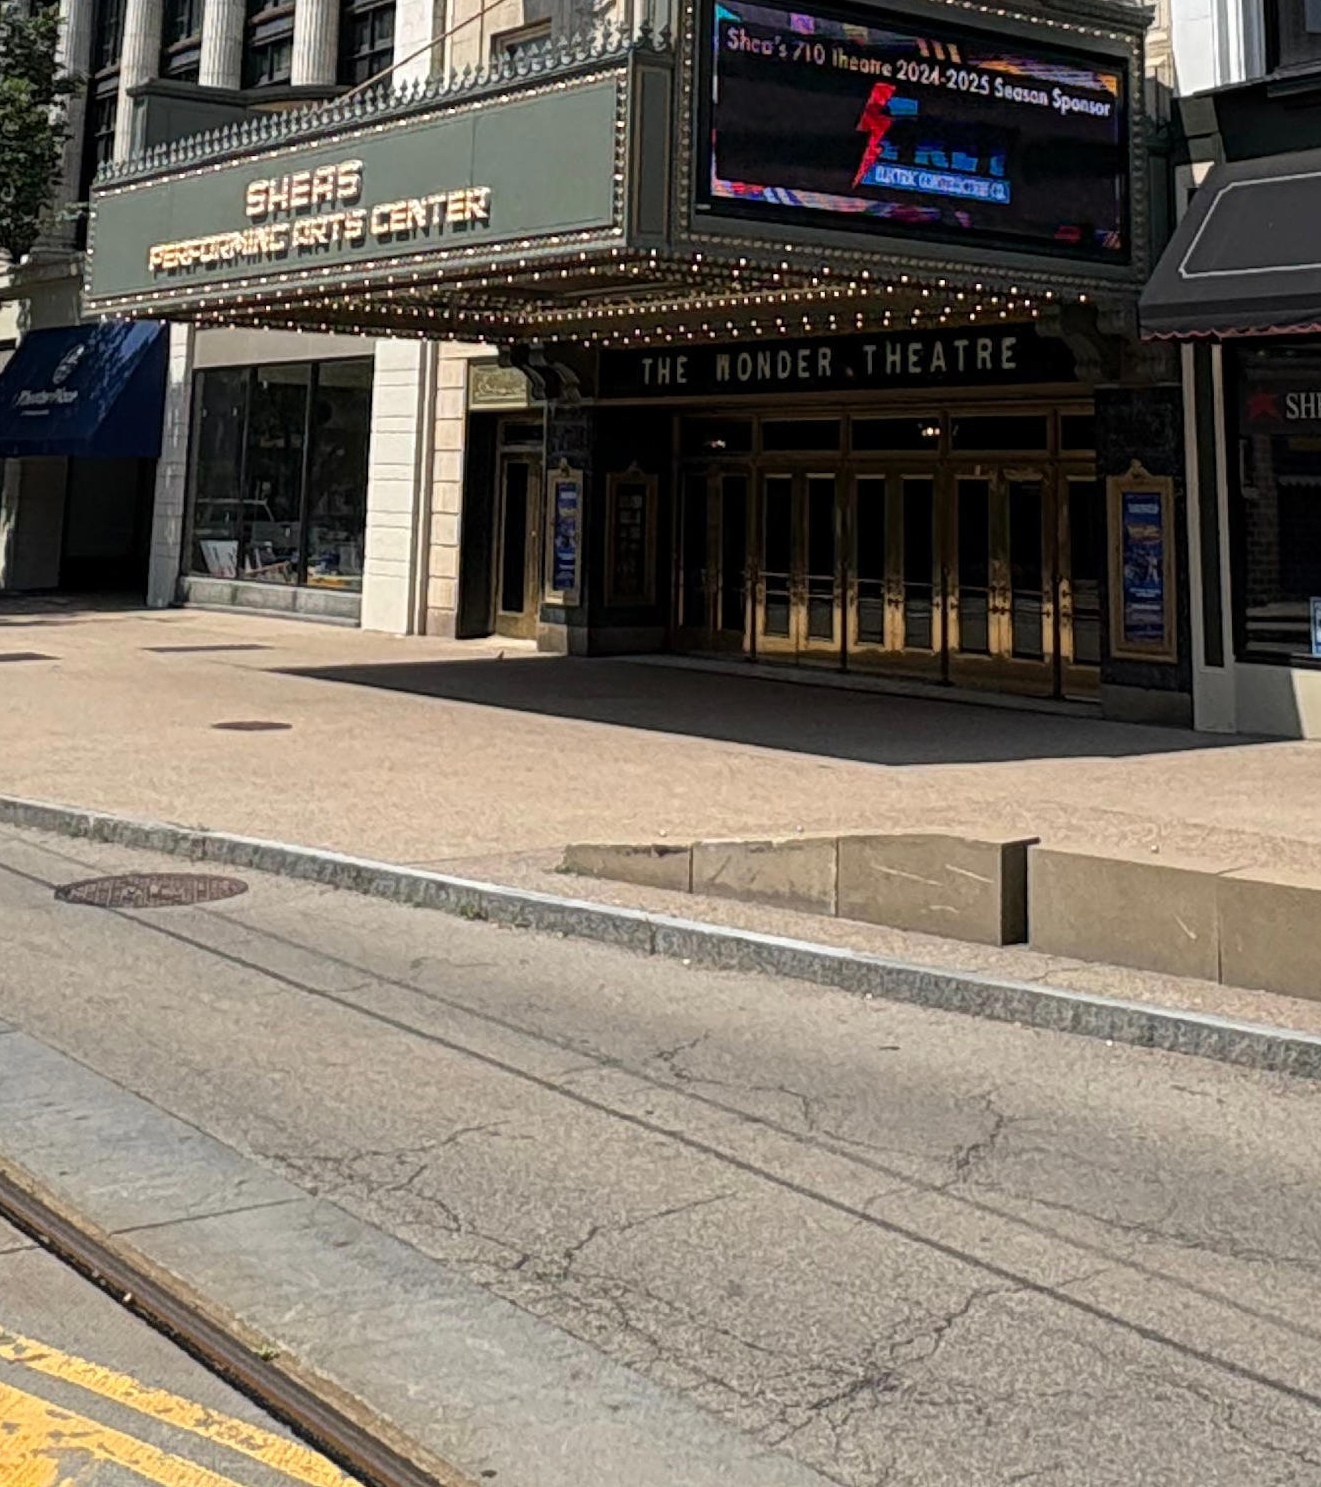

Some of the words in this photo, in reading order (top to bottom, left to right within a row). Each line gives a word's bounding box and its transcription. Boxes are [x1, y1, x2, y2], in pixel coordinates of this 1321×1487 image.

[792, 42, 825, 65] 710
[832, 48, 892, 77] Theatre
[896, 59, 990, 95] 2024-2025
[994, 78, 1048, 106] Season
[1052, 87, 1110, 116] Sponsor
[148, 221, 290, 272] PERFORMING
[292, 208, 367, 248] ARTS
[370, 186, 492, 235] CENTER
[642, 355, 689, 386] THE
[715, 346, 832, 382] WONDER
[862, 336, 1018, 377] THEATRE
